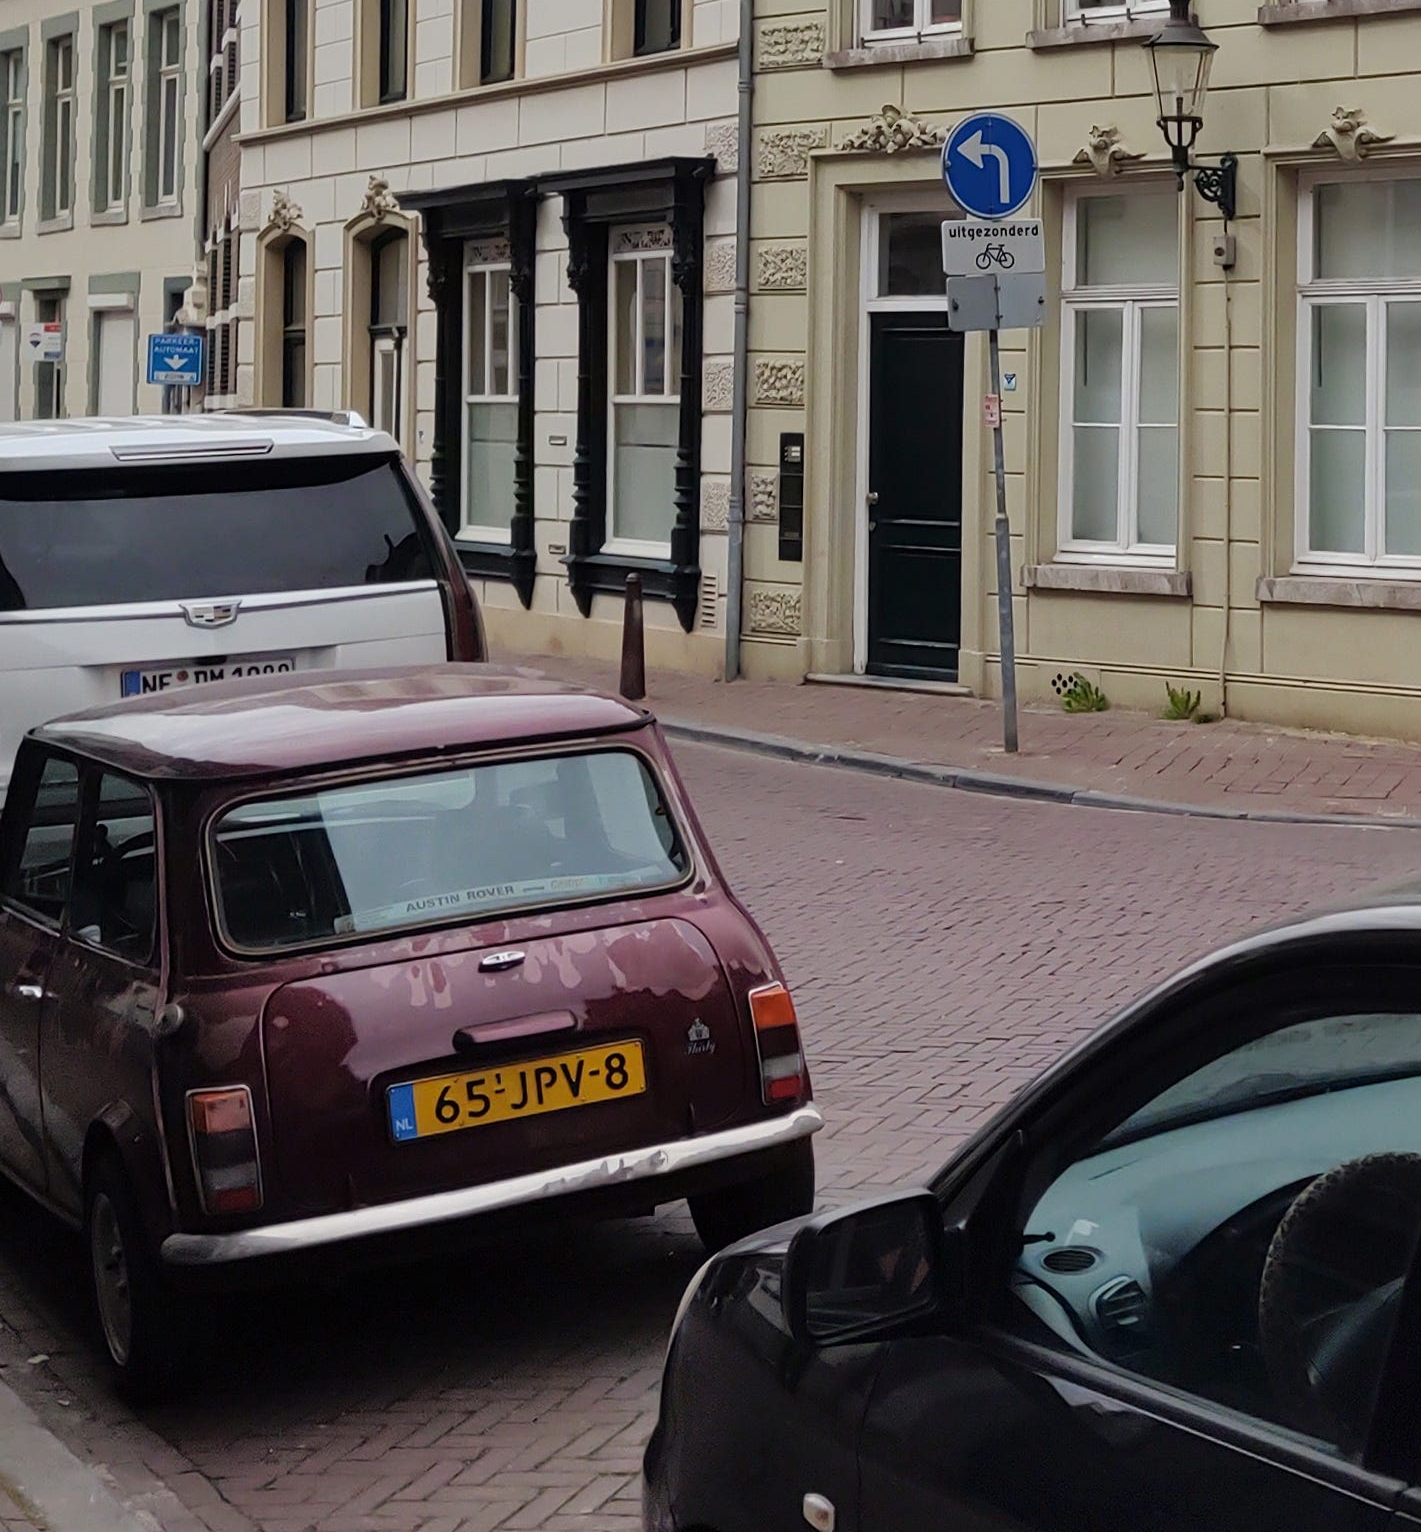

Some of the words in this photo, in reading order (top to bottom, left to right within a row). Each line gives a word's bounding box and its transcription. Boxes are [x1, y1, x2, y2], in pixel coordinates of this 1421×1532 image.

[948, 224, 1039, 241] uitgezonderd
[154, 346, 199, 354] AUTOMAAT
[406, 894, 460, 913] AUSTIN
[466, 885, 515, 901] ROVER
[435, 1053, 629, 1123] 65-JPV-8
[396, 1118, 413, 1131] NL
